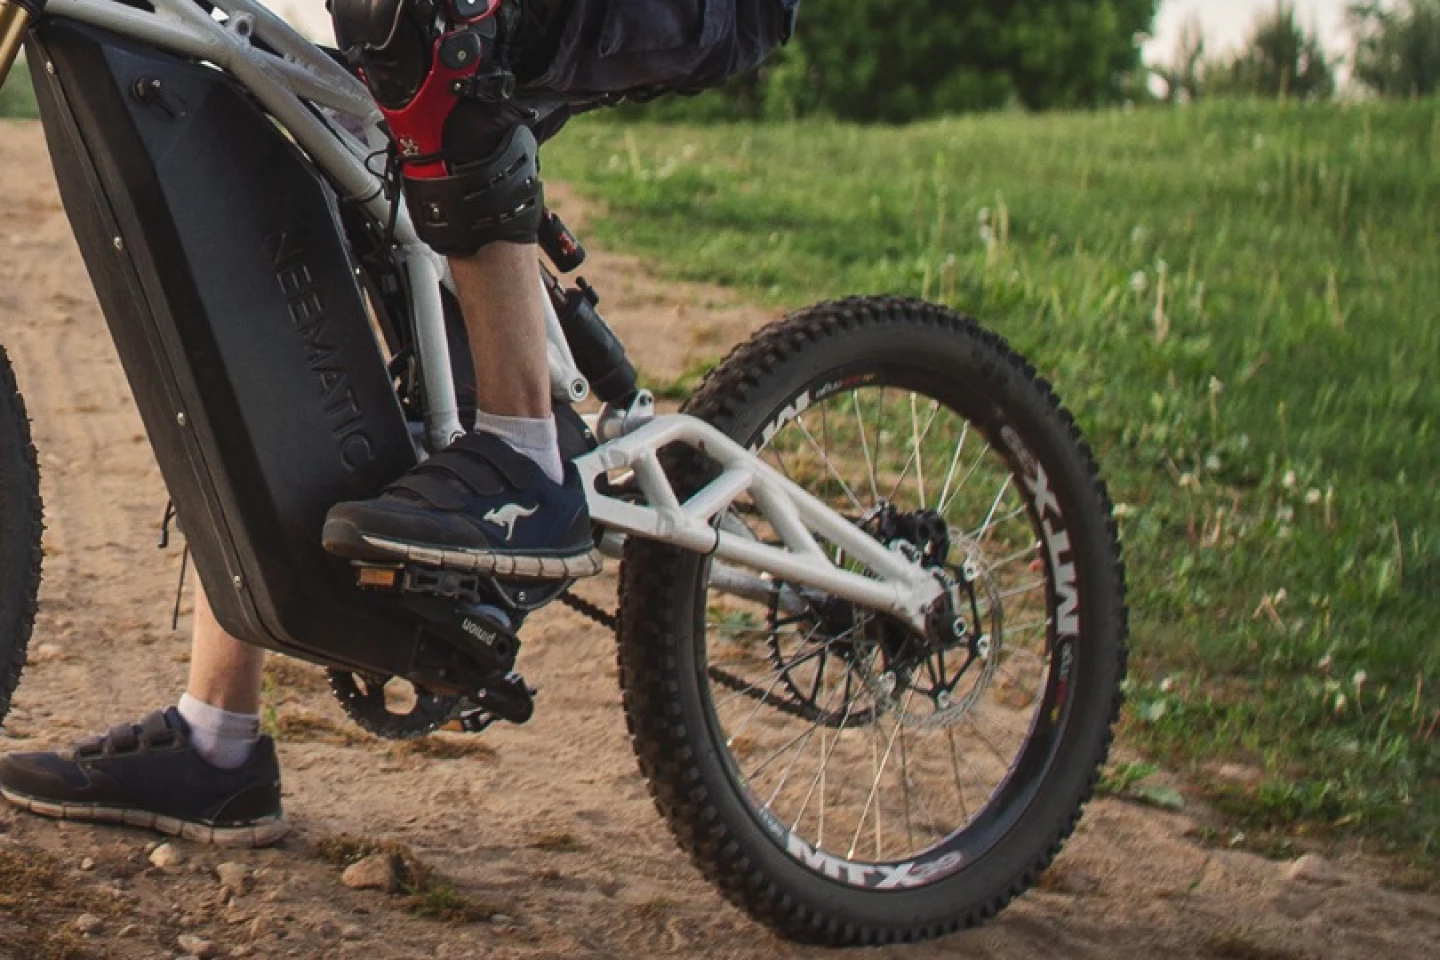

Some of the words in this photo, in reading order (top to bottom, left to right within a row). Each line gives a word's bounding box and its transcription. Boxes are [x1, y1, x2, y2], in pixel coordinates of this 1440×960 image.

[264, 229, 377, 472] NEEMATIC
[1022, 460, 1081, 636] MTX
[786, 832, 919, 889] MTX
